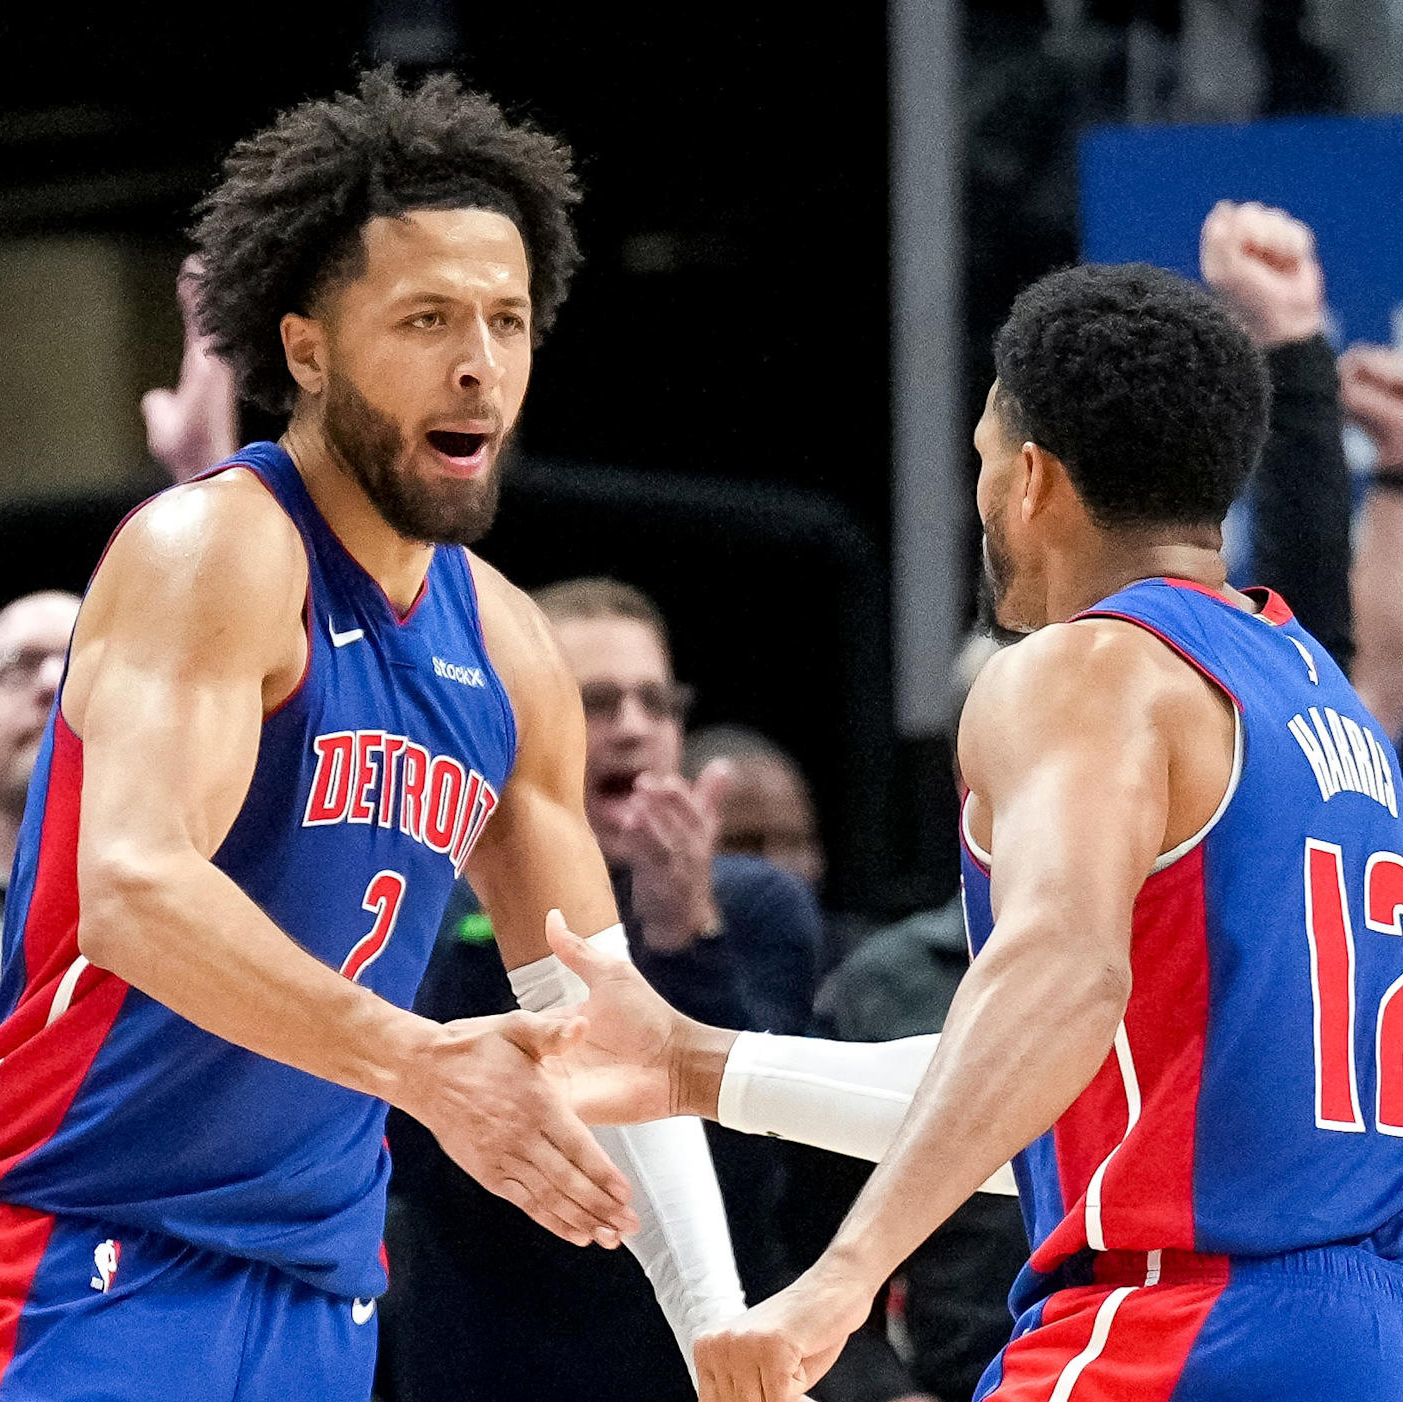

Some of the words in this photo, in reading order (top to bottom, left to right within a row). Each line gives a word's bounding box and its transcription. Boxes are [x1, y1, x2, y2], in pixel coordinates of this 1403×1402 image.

[302, 730, 498, 879] DETROIT
[1286, 706, 1399, 819] HARRIS
[339, 869, 406, 982] 2
